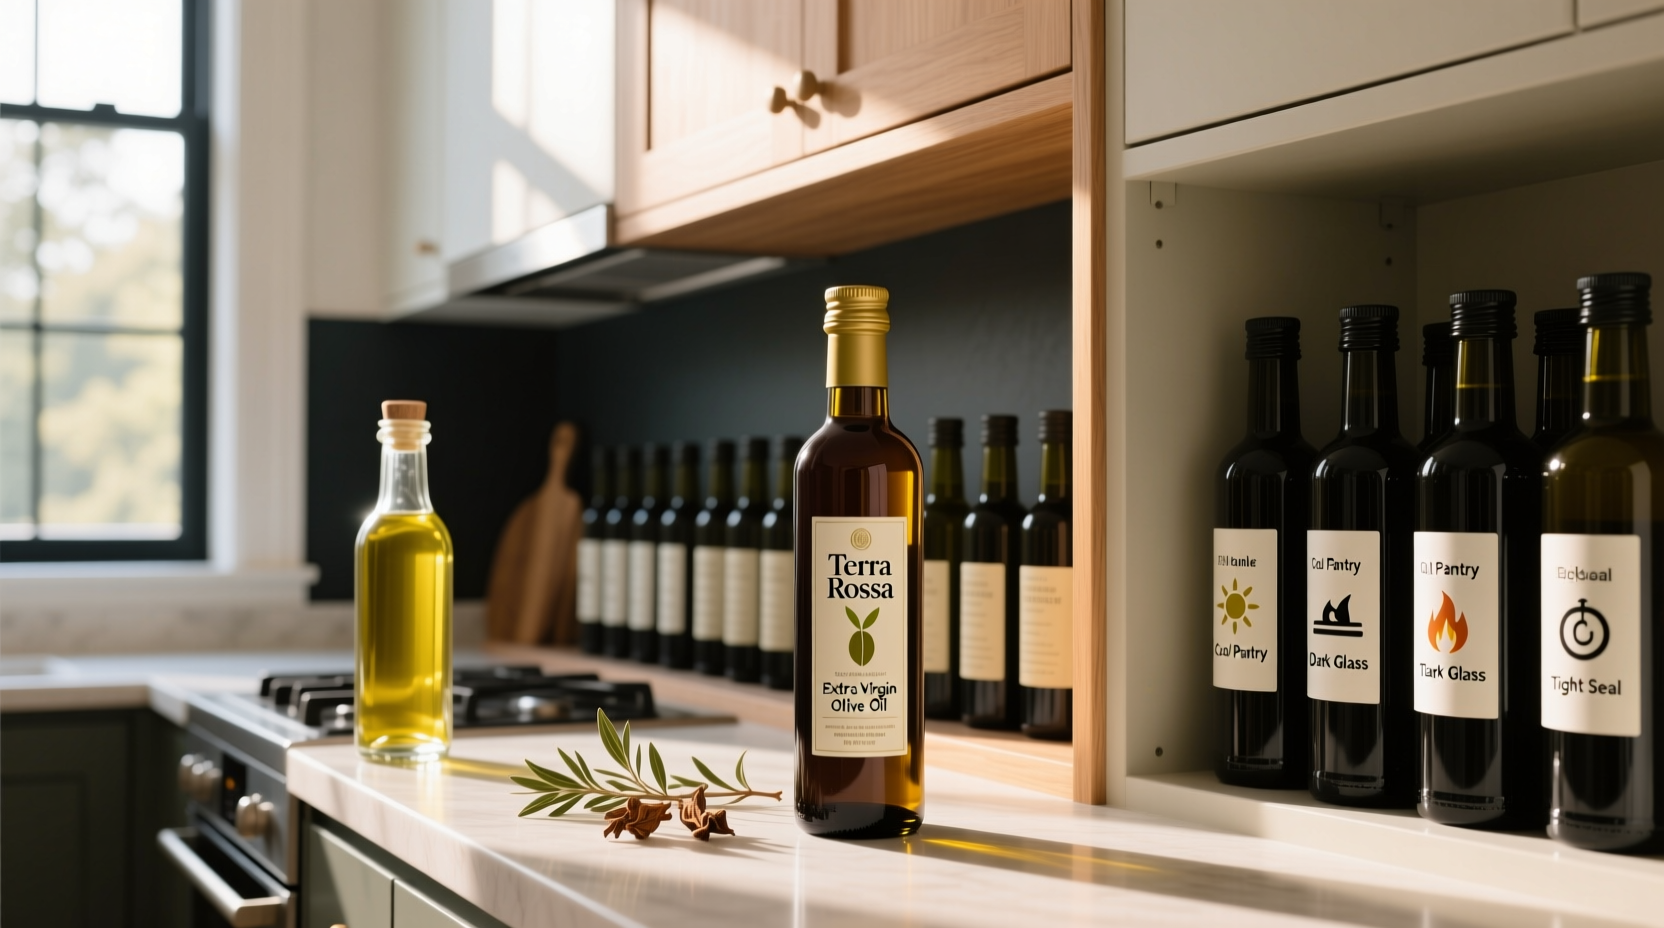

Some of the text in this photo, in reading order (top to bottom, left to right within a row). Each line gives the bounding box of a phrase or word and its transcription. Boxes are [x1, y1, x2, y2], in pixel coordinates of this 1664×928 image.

[828, 553, 892, 576] Terra
[1326, 557, 1361, 576] Pantry
[1435, 561, 1480, 580] Pantry
[827, 577, 894, 599] Rossa
[1309, 652, 1369, 670] Dark Glass
[1447, 665, 1487, 682] Glass
[822, 681, 897, 700] Extra Virgin
[1551, 675, 1622, 696] Tight Seal
[831, 697, 887, 713] Olive Oil
